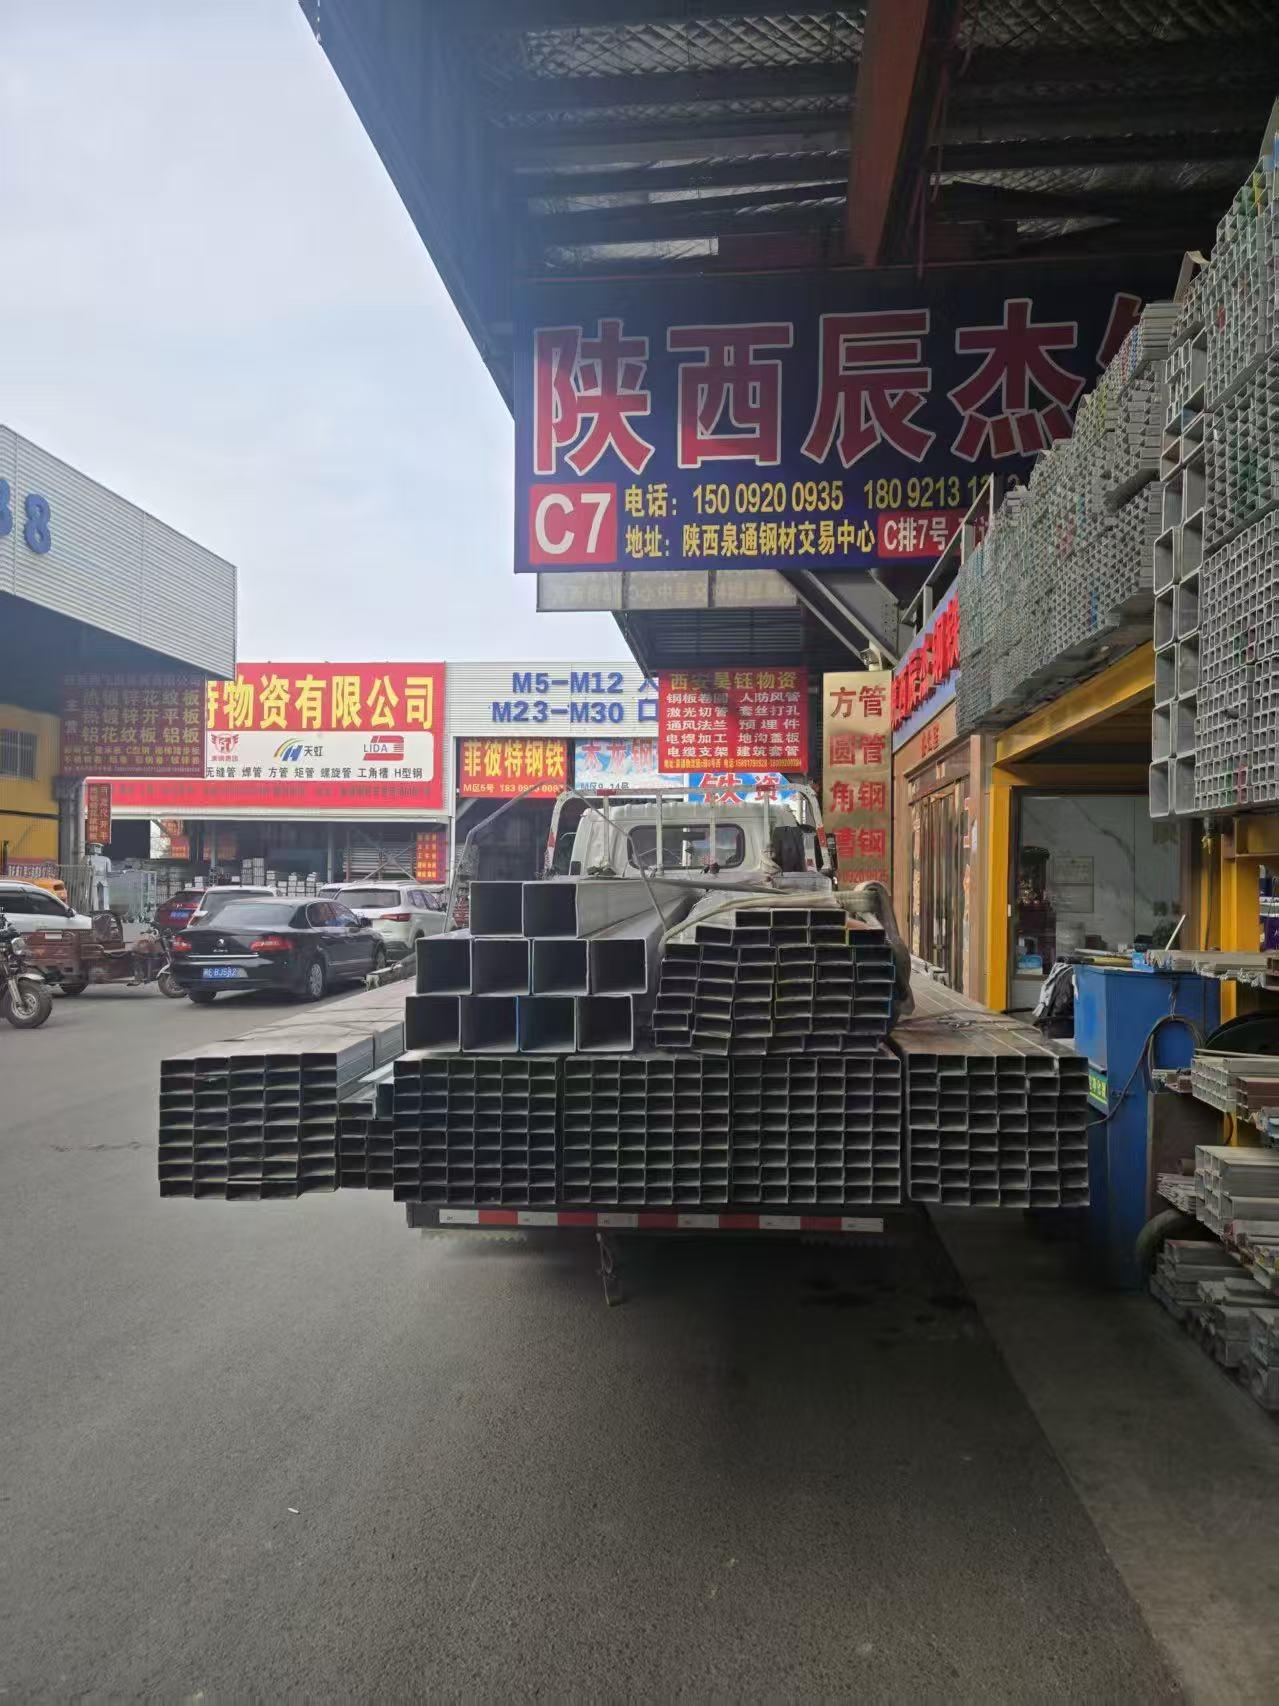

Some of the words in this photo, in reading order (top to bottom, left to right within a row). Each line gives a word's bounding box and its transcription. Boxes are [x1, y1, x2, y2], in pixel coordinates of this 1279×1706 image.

[533, 292, 1142, 477] 陕西辰杰
[693, 484, 730, 514] 150
[735, 482, 787, 513] 0920
[791, 480, 844, 511] 0935
[864, 478, 902, 509] 180
[907, 476, 960, 507] 9213
[535, 493, 611, 554] C7
[682, 519, 876, 557] 陕西泉通钢材交易中心
[884, 516, 949, 552] C排7号
[830, 685, 887, 719] 方管
[666, 719, 729, 731] 通风法兰
[304, 745, 324, 758] 天虹
[363, 743, 388, 753] LIDA
[829, 733, 887, 767] 圆管
[268, 767, 289, 779] 方管
[830, 781, 887, 813] 角钢
